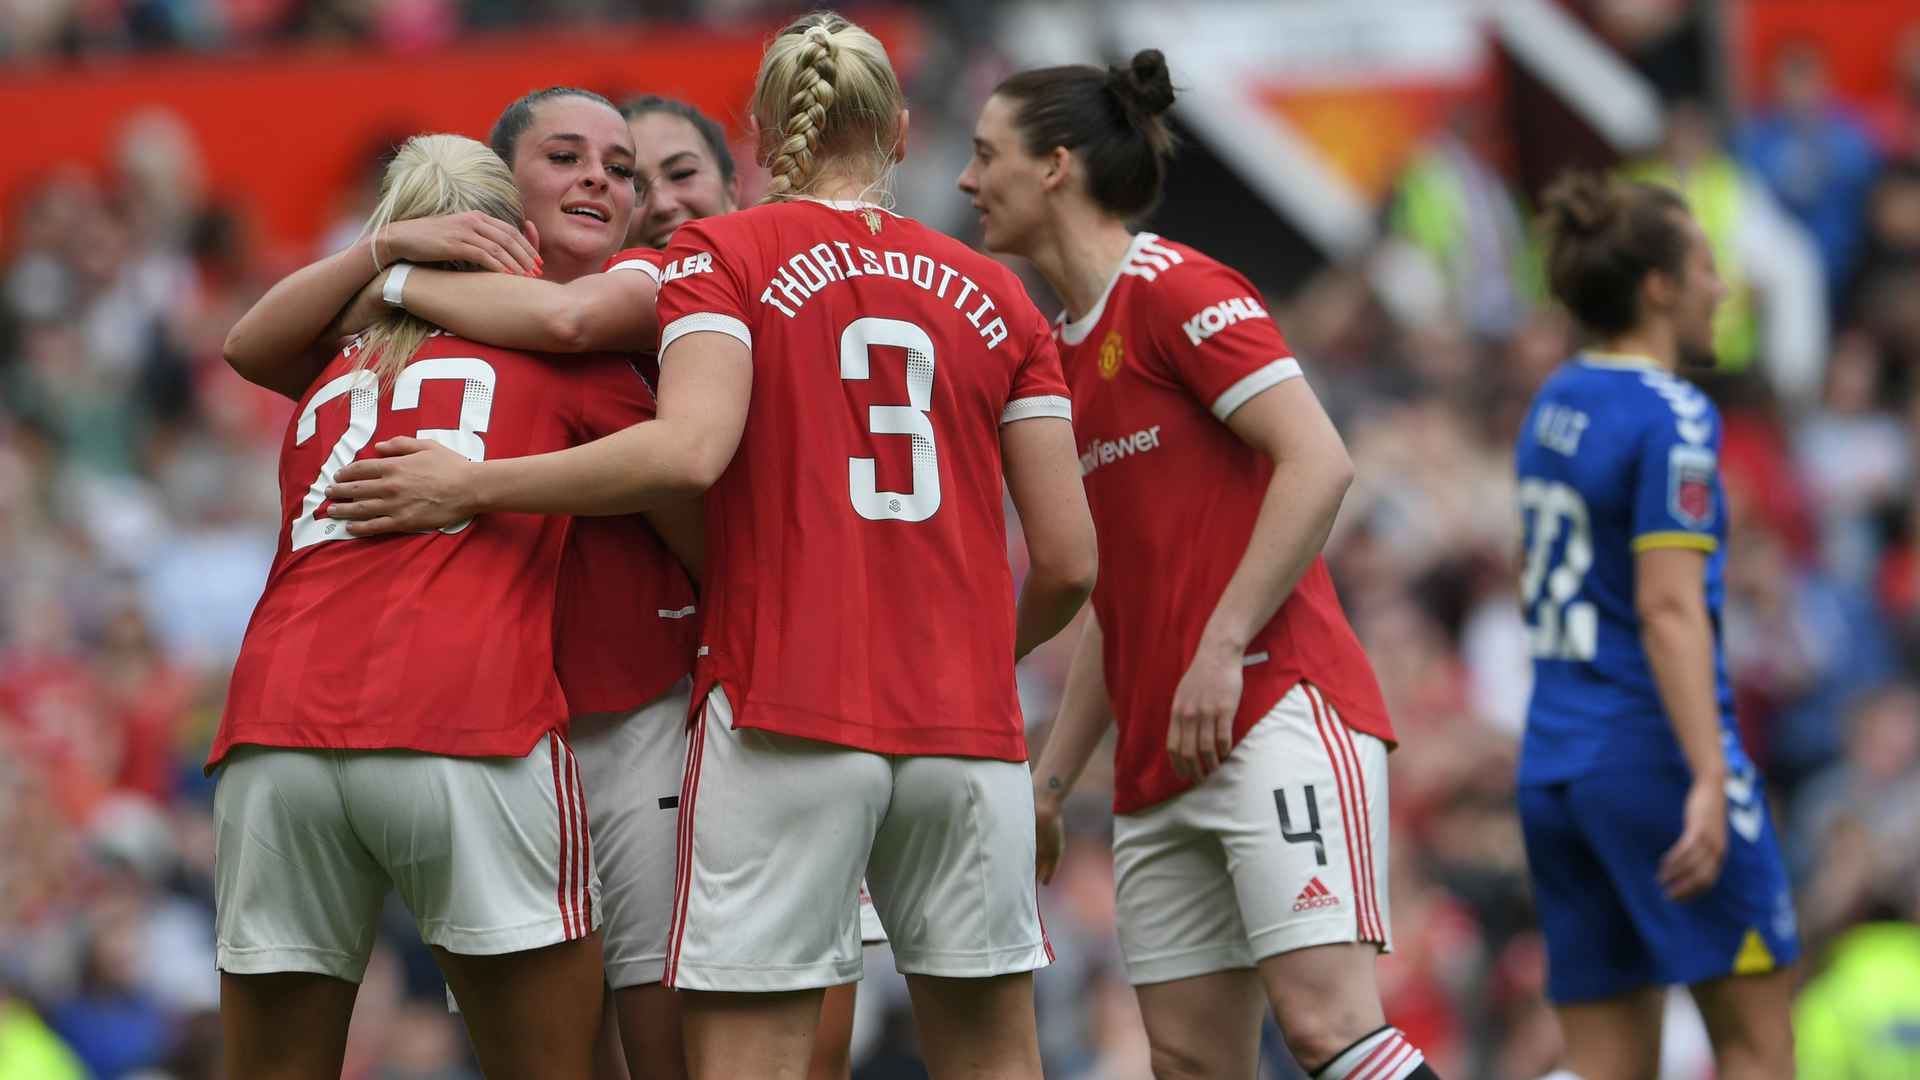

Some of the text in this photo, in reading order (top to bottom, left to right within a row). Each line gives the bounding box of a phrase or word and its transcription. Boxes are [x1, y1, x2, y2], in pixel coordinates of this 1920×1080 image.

[291, 357, 496, 553] 23
[840, 317, 941, 522] 3
[1273, 785, 1328, 866] 4
[1292, 896, 1340, 912] adidas
